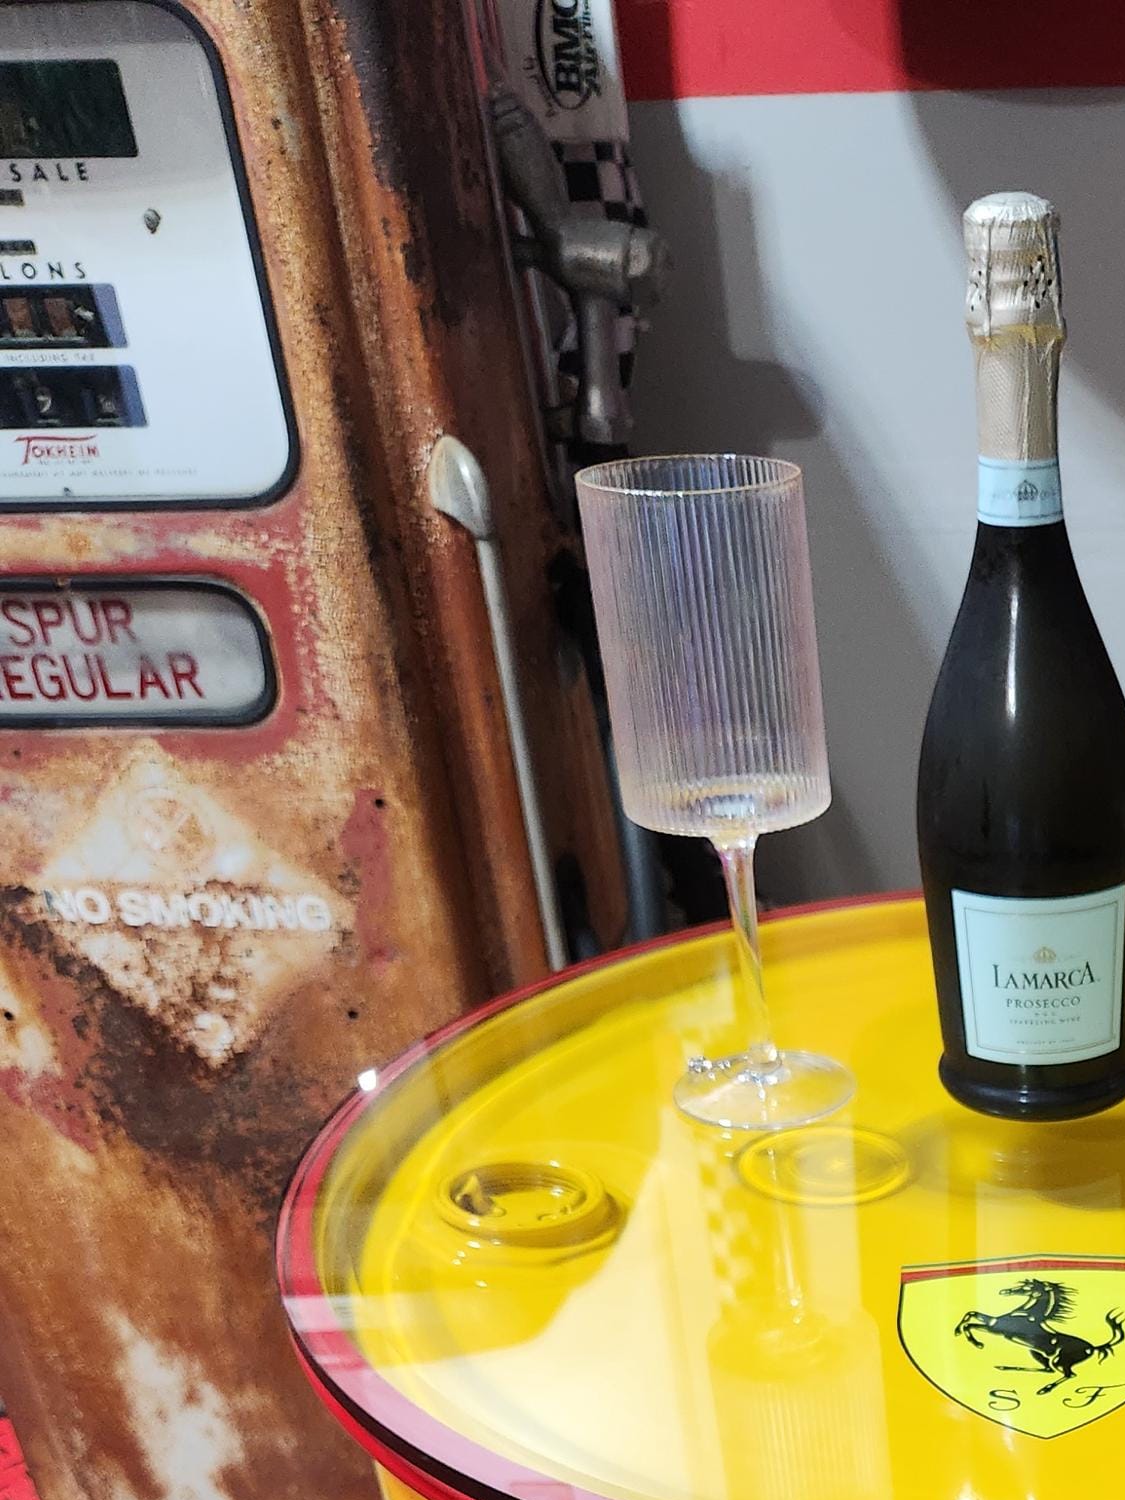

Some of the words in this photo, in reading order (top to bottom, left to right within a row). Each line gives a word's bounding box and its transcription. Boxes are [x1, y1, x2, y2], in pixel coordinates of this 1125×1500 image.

[9, 162, 89, 182] SALE
[2, 600, 138, 647] SPUR
[0, 652, 206, 701] EGULAR
[43, 889, 109, 925] NO
[116, 890, 331, 932] SMOKING
[1006, 996, 1081, 1009] PROSECCO
[988, 1389, 1021, 1412] S
